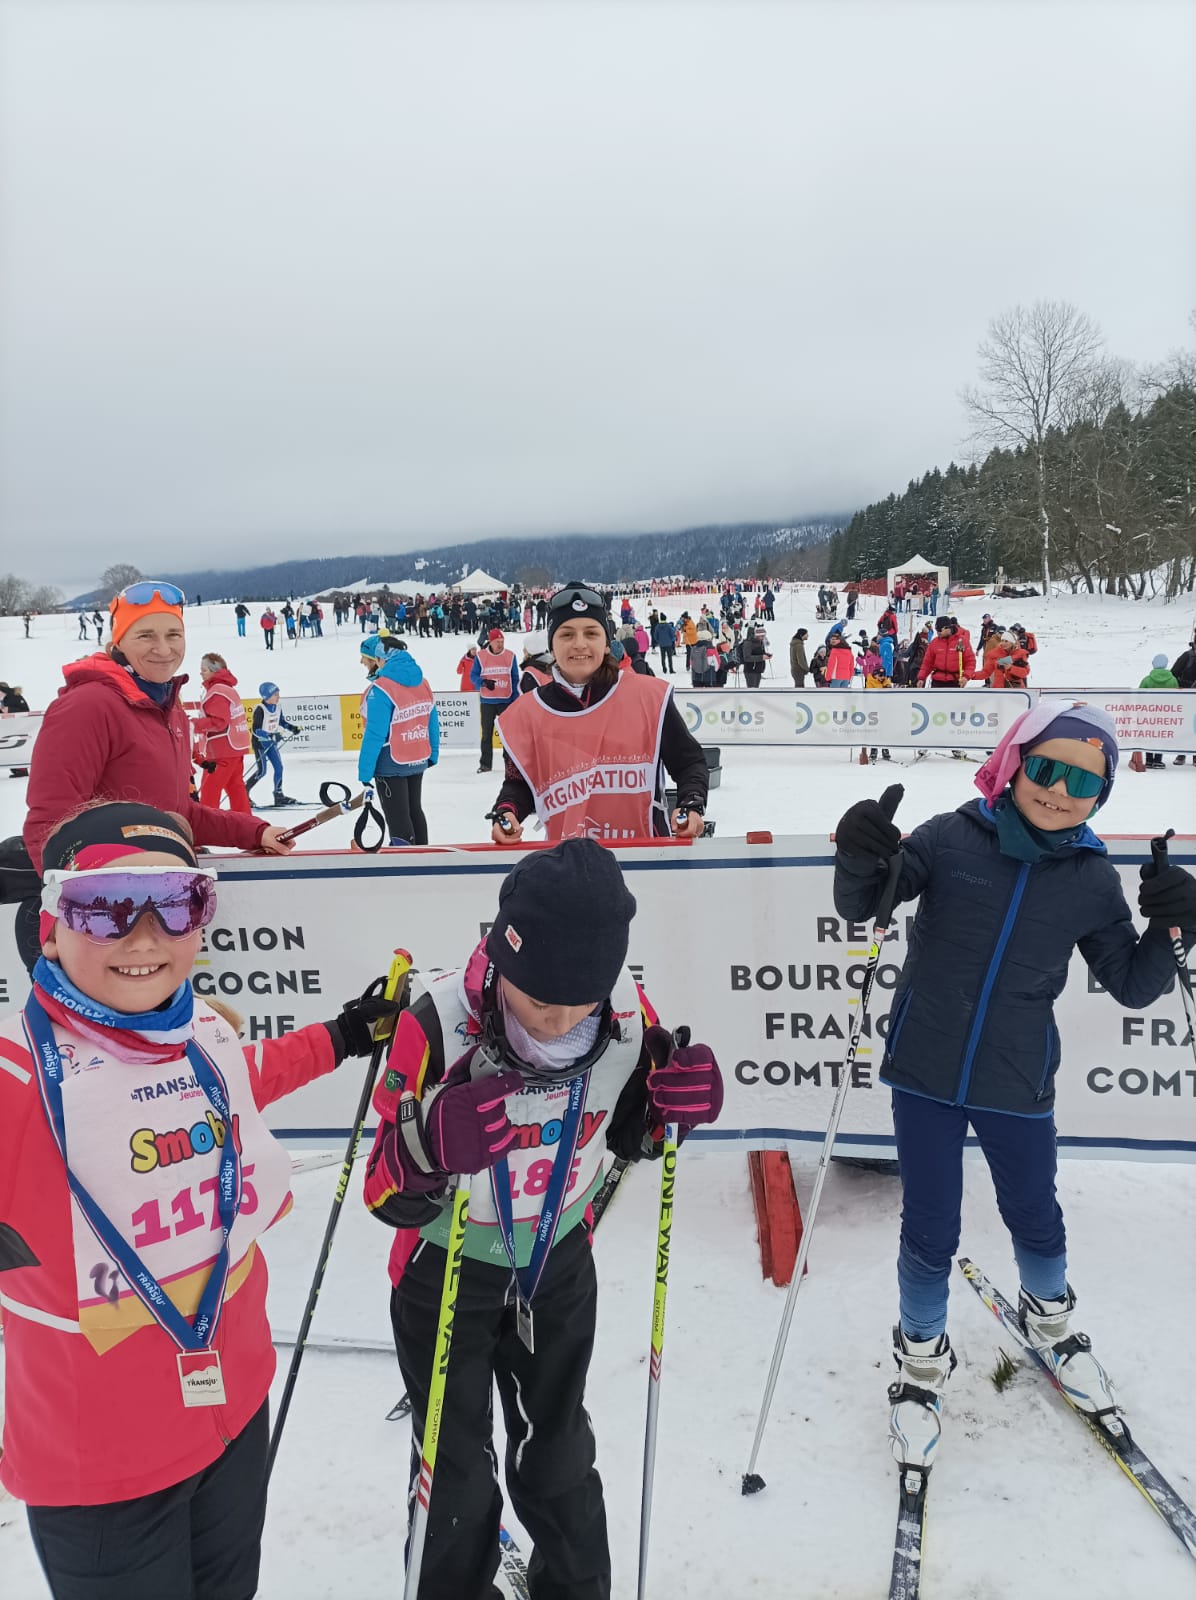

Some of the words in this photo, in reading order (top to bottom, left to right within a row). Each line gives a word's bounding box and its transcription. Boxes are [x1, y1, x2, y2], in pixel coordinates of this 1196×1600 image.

[285, 713, 333, 721] OURGOGNE
[1105, 704, 1183, 713] CHAMPAGNOLE
[1117, 729, 1174, 739] ONTARLIER
[194, 969, 322, 995] GOGNE
[734, 1059, 873, 1089] COMTE
[660, 1150, 677, 1221] ONE
[656, 1224, 673, 1287] WAY
